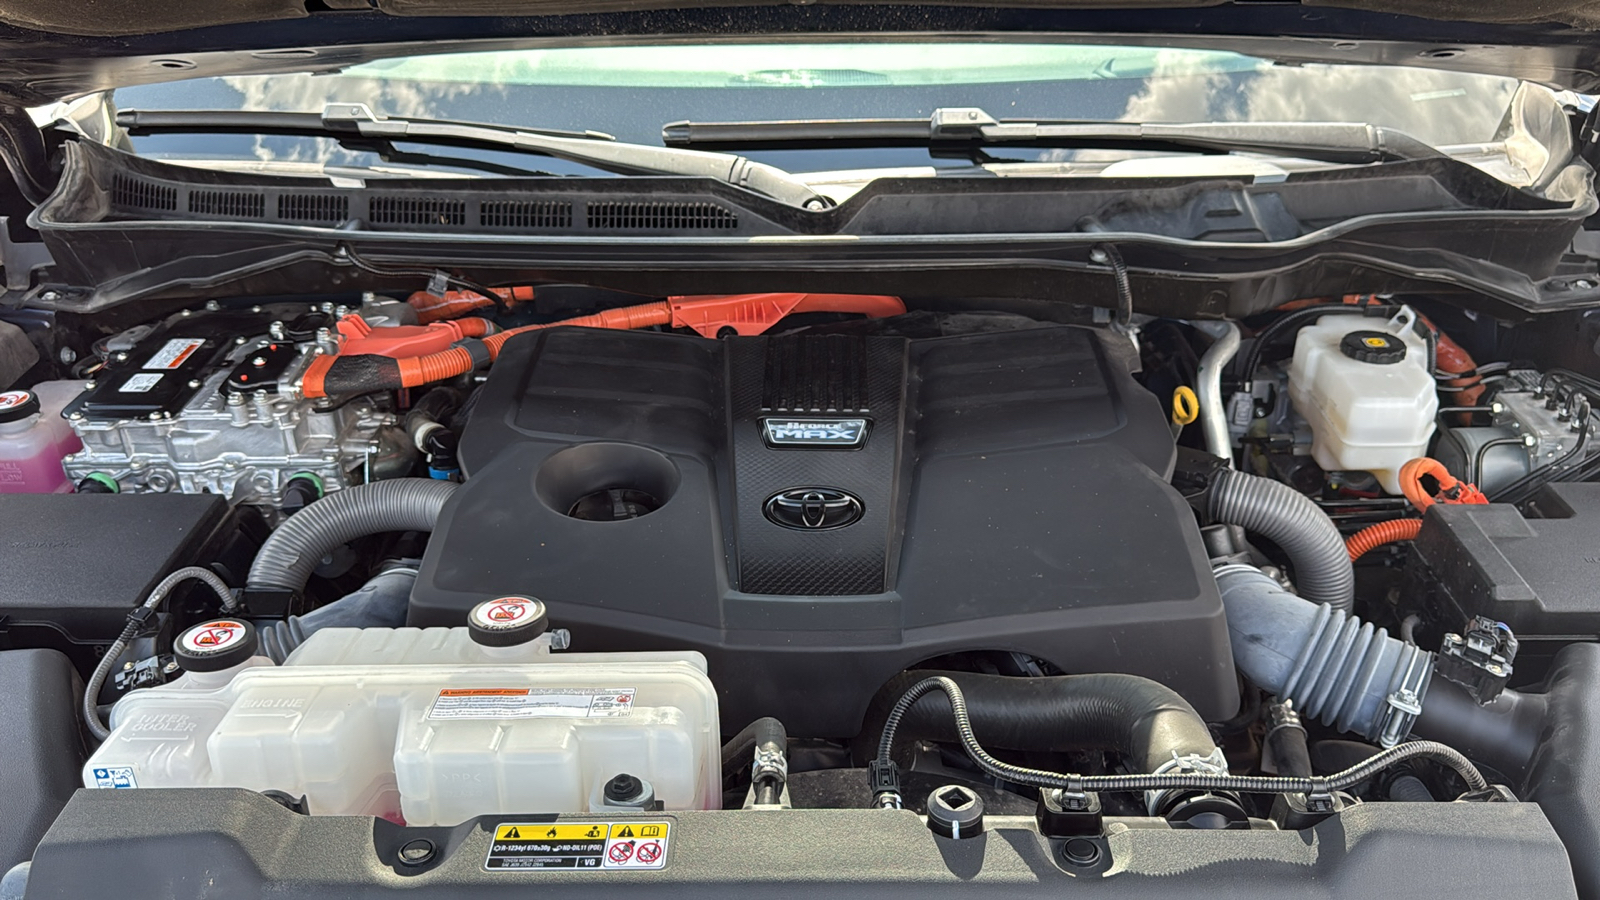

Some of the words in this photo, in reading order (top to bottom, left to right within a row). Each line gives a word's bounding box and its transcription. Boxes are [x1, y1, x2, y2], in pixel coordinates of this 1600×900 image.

[775, 429, 856, 440] MAX
[240, 699, 305, 709] ENGINE
[138, 713, 190, 724] INTER
[131, 722, 197, 732] COOLER
[500, 844, 527, 853] R-1234yf
[562, 844, 587, 852] ND-OIL11
[587, 844, 603, 852] (POE)
[584, 858, 596, 867] VG
